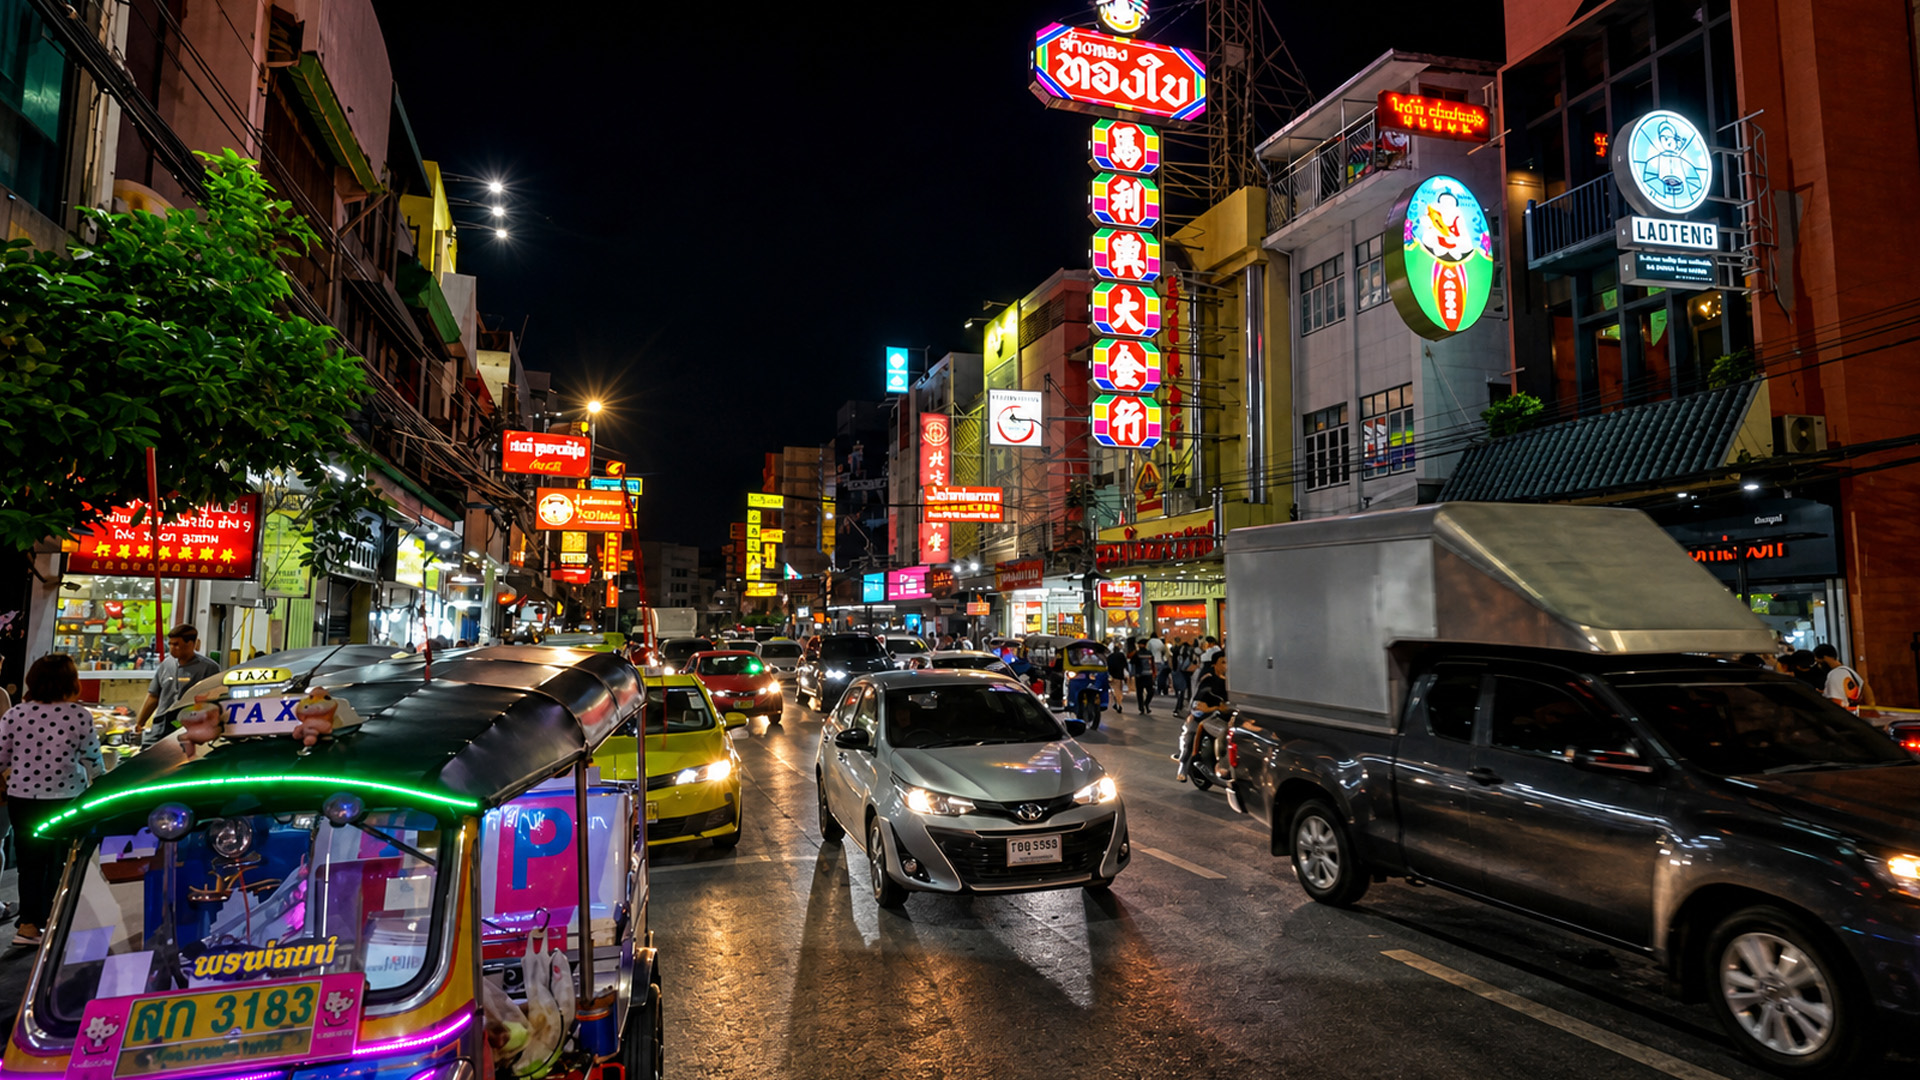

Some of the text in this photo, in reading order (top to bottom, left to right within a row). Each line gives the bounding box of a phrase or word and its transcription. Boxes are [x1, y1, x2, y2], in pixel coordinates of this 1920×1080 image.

[1637, 221, 1713, 245] LAOTENG
[236, 670, 279, 681] TAXI
[512, 807, 573, 890] P
[211, 986, 314, 1034] 3183
